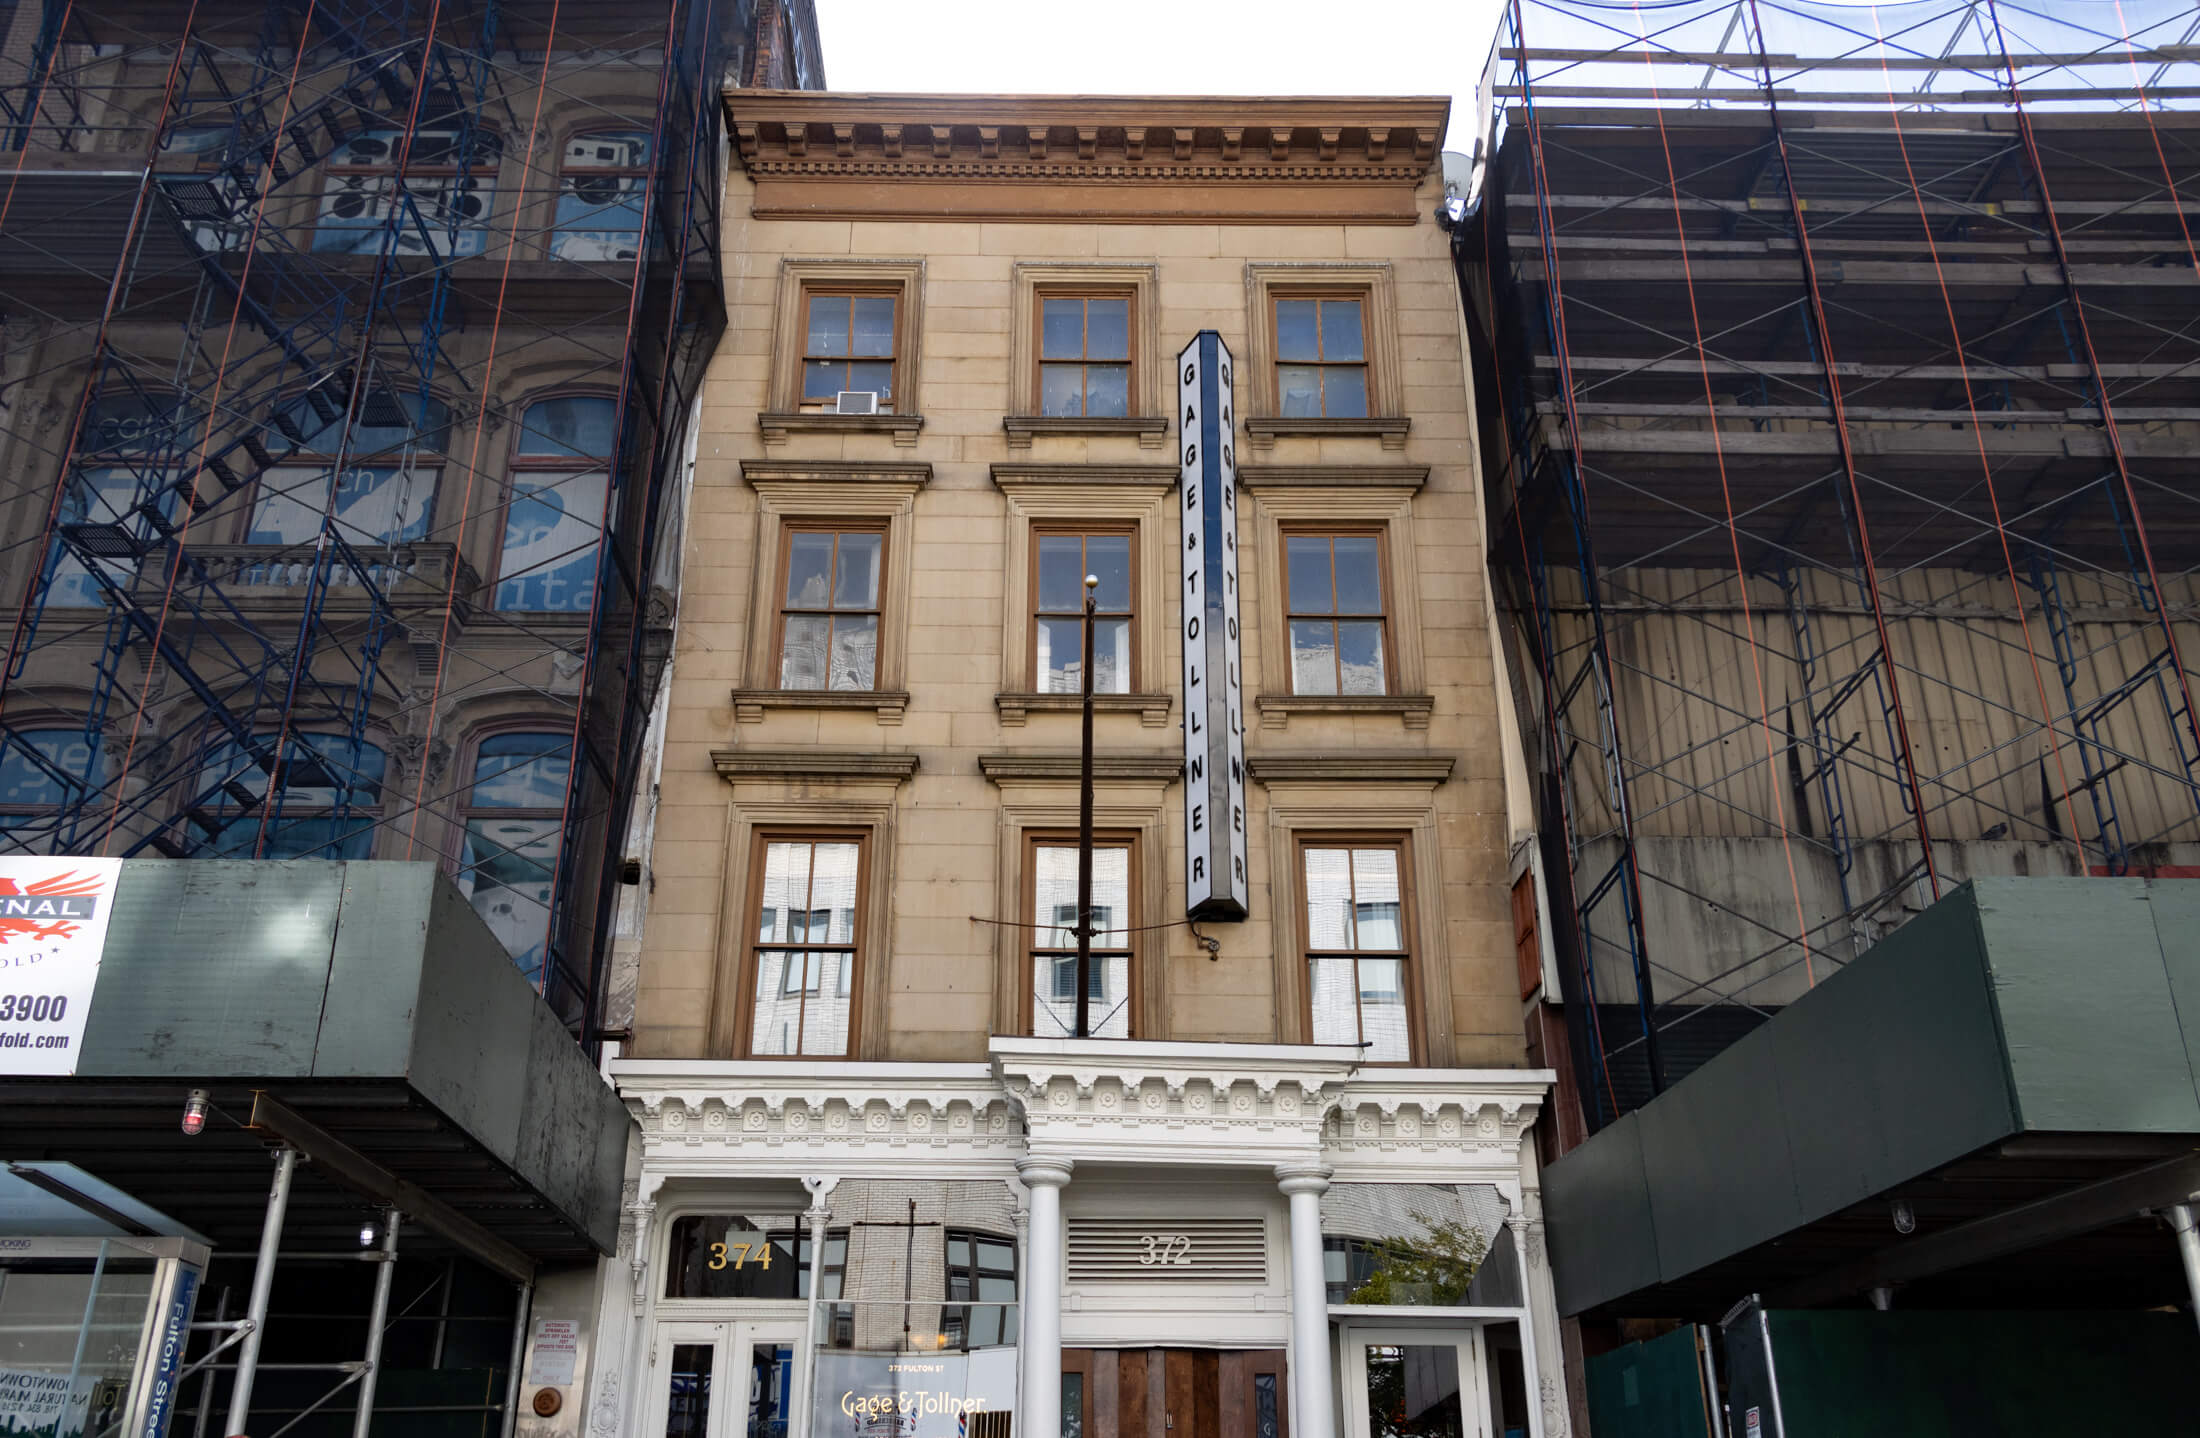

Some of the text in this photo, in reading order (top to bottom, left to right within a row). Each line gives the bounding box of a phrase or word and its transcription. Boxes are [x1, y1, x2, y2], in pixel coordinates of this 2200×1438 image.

[1183, 363, 1205, 884] GAGE & TOLLNER
[1221, 363, 1244, 885] GAGE & TOLLNER
[0, 899, 81, 916] NAL
[0, 994, 68, 1023] 3900
[708, 1242, 773, 1271] 374
[1138, 1235, 1193, 1265] 372
[160, 1302, 185, 1372] Fulton
[903, 1364, 934, 1372] FULTON
[935, 1364, 944, 1372] ST
[841, 1391, 893, 1421] Gage
[898, 1391, 913, 1413] &
